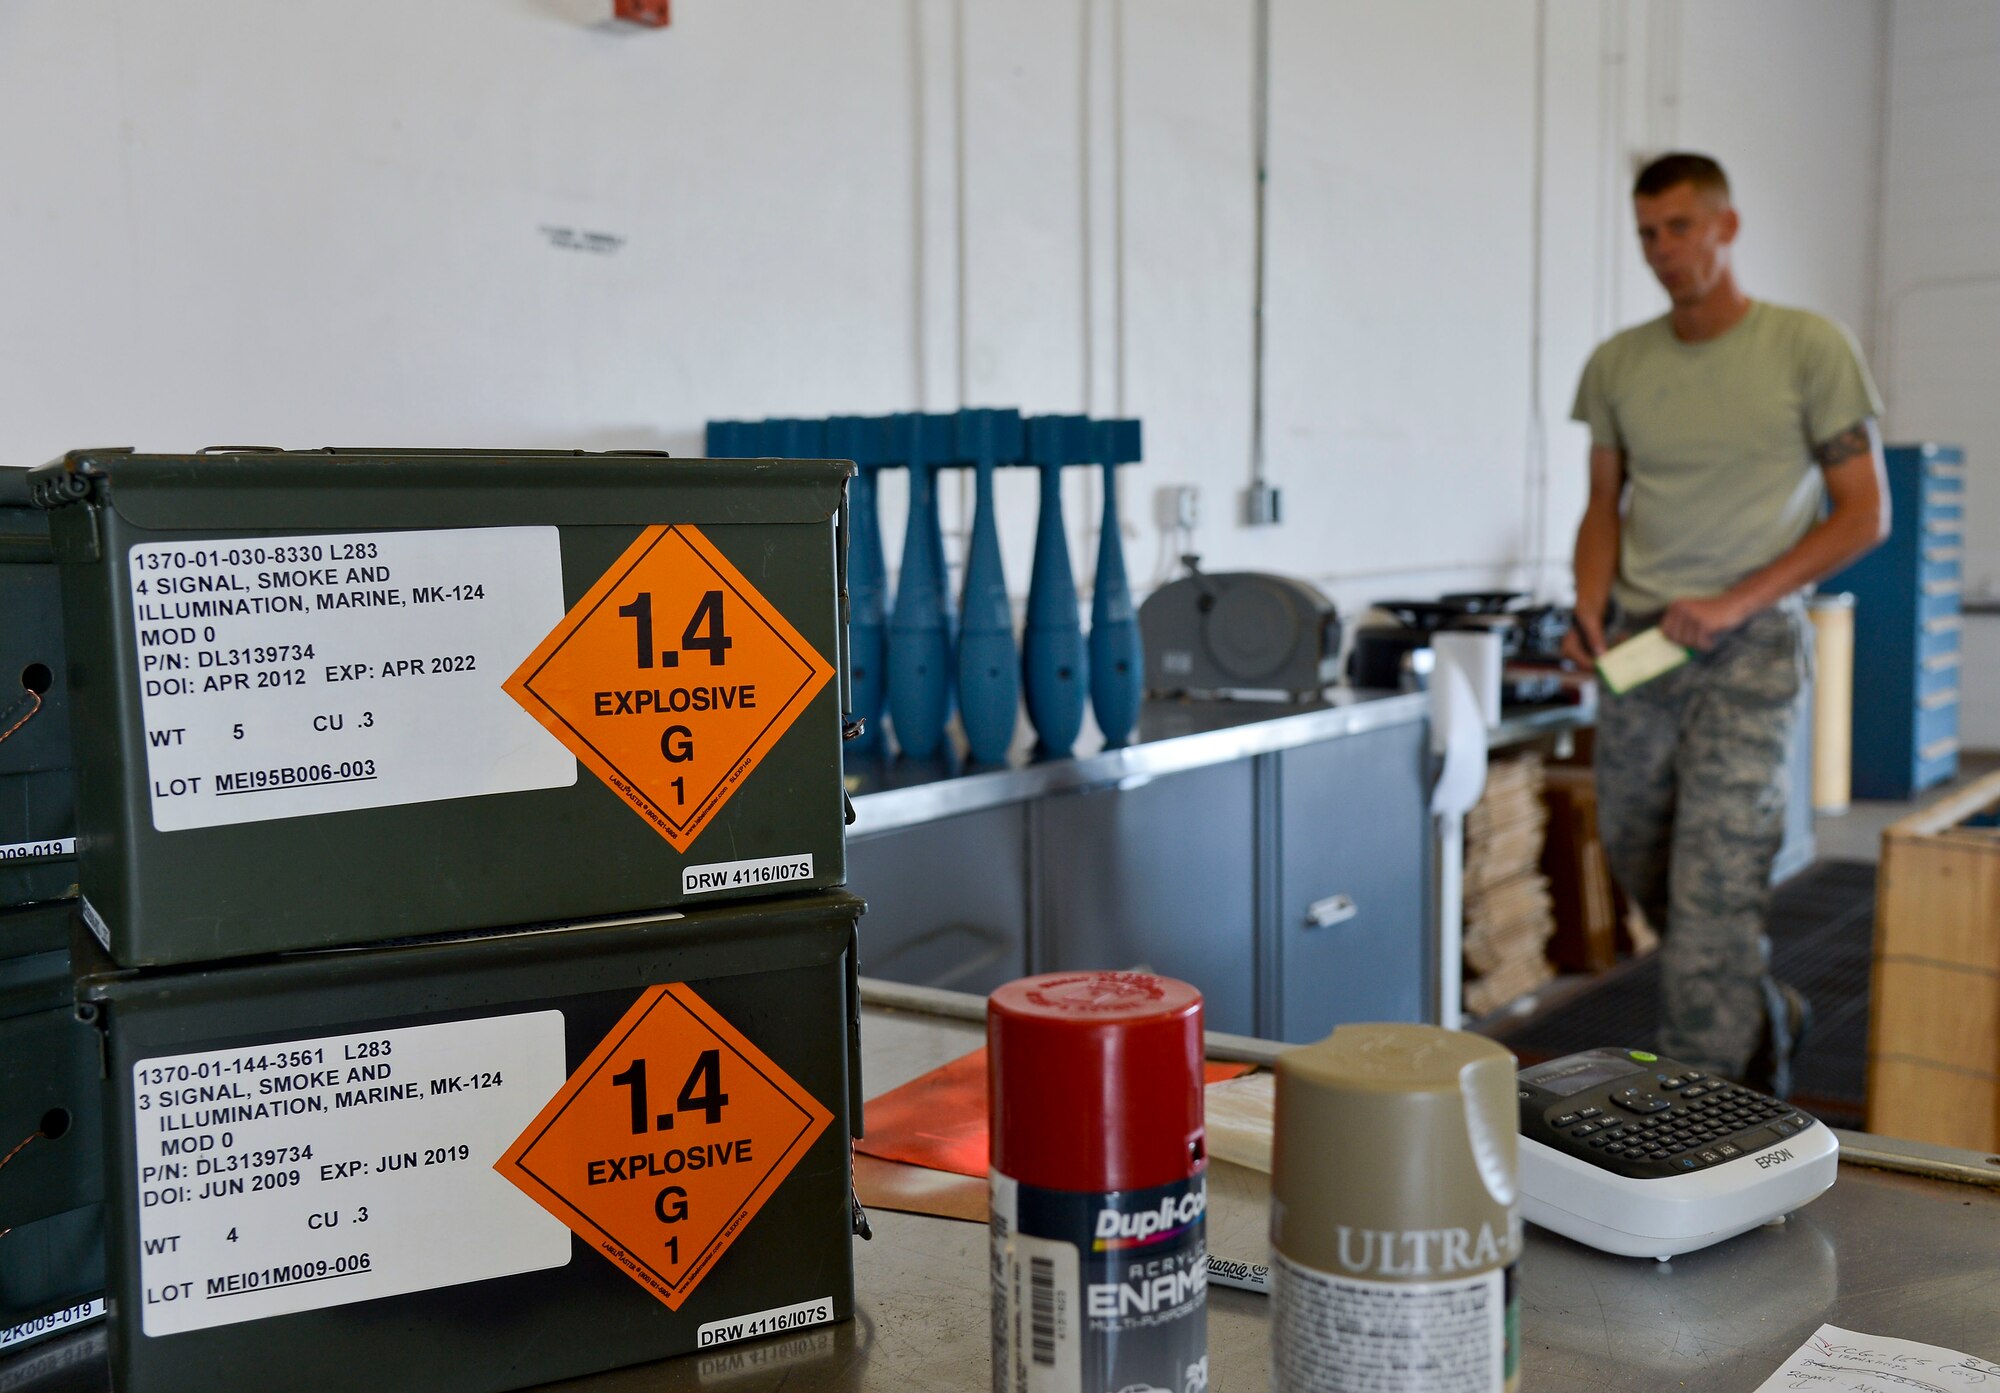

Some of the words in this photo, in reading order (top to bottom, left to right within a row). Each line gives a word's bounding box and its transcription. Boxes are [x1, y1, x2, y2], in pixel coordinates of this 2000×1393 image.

[136, 546, 322, 570] 1370-01-030-8330
[330, 543, 377, 560] L283
[136, 580, 148, 595] 4
[157, 575, 249, 594] SIGNAL,
[258, 569, 338, 588] SMOKE
[346, 566, 390, 584] AND
[139, 596, 309, 620] ILLUMINATION,
[317, 590, 406, 610] MARINE,
[413, 584, 484, 603] MK-124
[142, 628, 195, 646] MOD
[204, 626, 215, 642] 0
[619, 590, 732, 669] 1.4
[144, 654, 189, 671] P/N:
[198, 644, 315, 667] DL3139734
[146, 678, 194, 696] DOI:
[204, 674, 250, 692] APR
[258, 669, 306, 688] 2012
[326, 664, 374, 682] EXP:
[382, 660, 425, 677] APR
[432, 655, 476, 673] 2022
[594, 685, 756, 716] EXPLOSIVE
[150, 729, 186, 746] WT
[234, 724, 244, 739] 5
[314, 714, 343, 731] CU
[358, 712, 374, 728] .3
[660, 725, 694, 763] G
[156, 778, 201, 797] LOT
[216, 760, 377, 796] MEI95B006-003
[671, 776, 684, 805] 1
[686, 871, 728, 890] DRW
[733, 862, 810, 885] 4116/I07S
[139, 1048, 325, 1086] 1370-01-144-3561
[345, 1040, 391, 1060] L283
[140, 1094, 150, 1110] 3
[160, 1083, 251, 1107] SIGNAL,
[260, 1070, 339, 1094] SMOKE
[347, 1064, 391, 1083] AND
[161, 1093, 327, 1132] ILLUMINATION,
[336, 1083, 423, 1108] MARINE,
[431, 1072, 502, 1095] MK-124
[612, 1049, 729, 1135] 1.4
[162, 1135, 214, 1156] MOD
[222, 1132, 233, 1148] 0
[587, 1139, 752, 1186] EXPLOSIVE
[1755, 1148, 1794, 1169] EPSON
[144, 1163, 187, 1183] P/N:
[197, 1145, 313, 1175] DL3139734
[144, 1187, 190, 1207] DOI:
[200, 1178, 243, 1199] JUN
[252, 1170, 300, 1191] 2009
[321, 1161, 368, 1181] EXP:
[376, 1152, 417, 1172] JUN
[424, 1145, 469, 1165] 2019
[654, 1186, 689, 1224] G
[145, 1236, 180, 1255] WT
[227, 1228, 238, 1242] 4
[308, 1211, 338, 1229] CU
[353, 1207, 368, 1223] .3
[664, 1235, 678, 1265] 1
[148, 1282, 193, 1304] LOT
[207, 1253, 372, 1299] MEI01M009-006
[1206, 1254, 1249, 1278] harpie
[0, 1302, 92, 1344] 2K009-019
[702, 1324, 744, 1346] DRW
[749, 1306, 827, 1336] 4116/I07S
